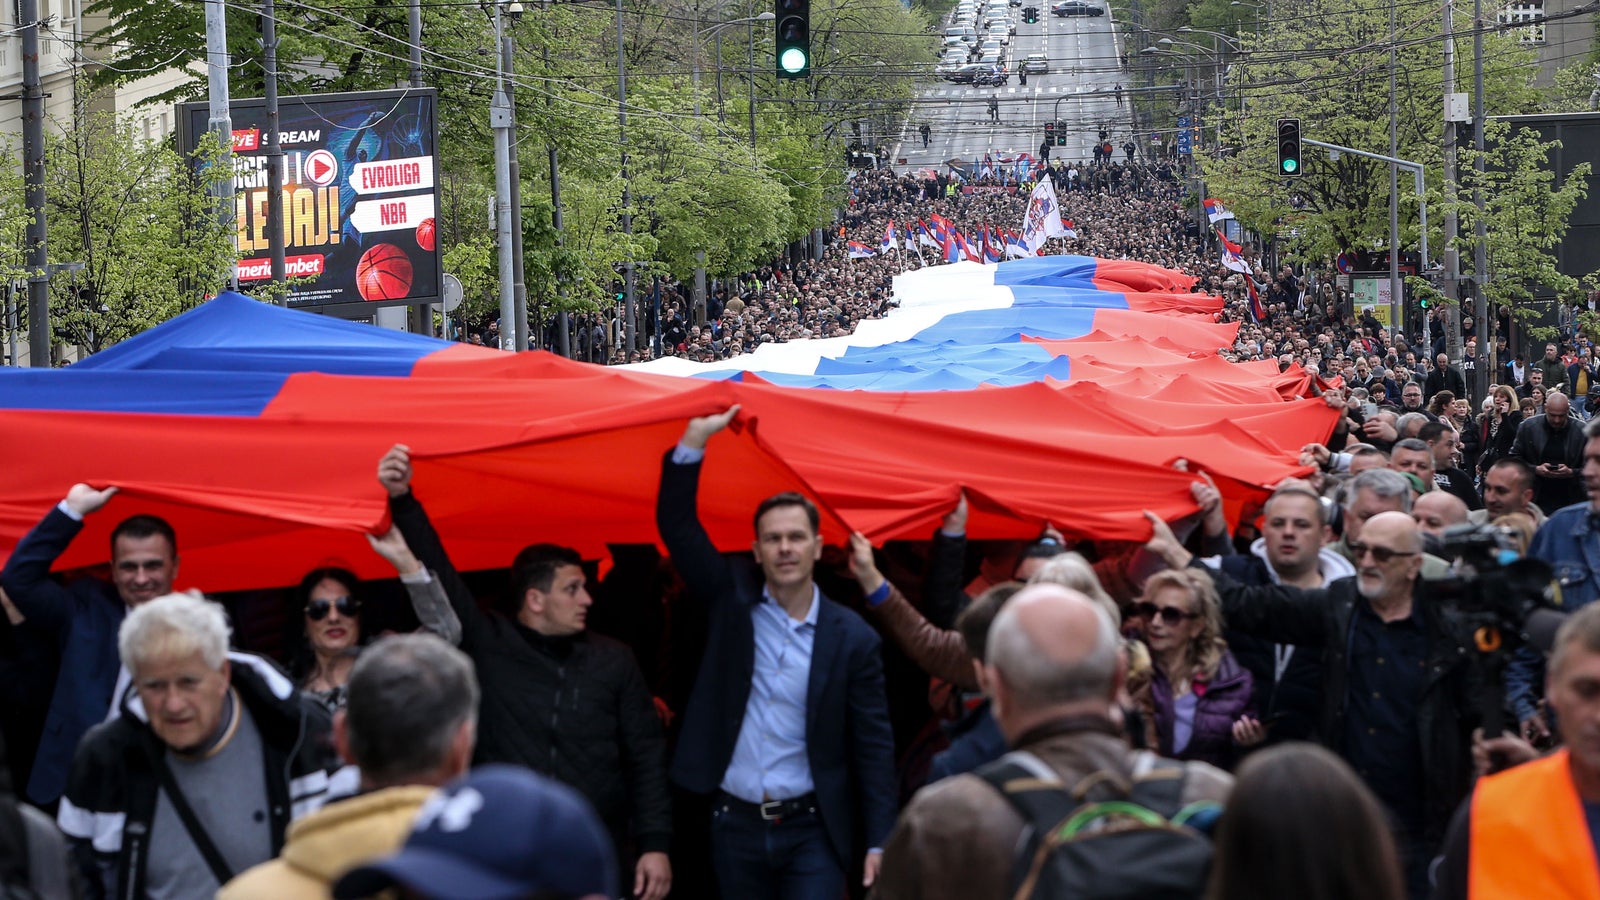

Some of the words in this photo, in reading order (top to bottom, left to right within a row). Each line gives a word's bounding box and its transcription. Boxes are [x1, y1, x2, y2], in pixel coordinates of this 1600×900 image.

[262, 130, 320, 145] SREAM
[362, 163, 420, 189] EVROLIGA
[380, 202, 407, 226] NBA
